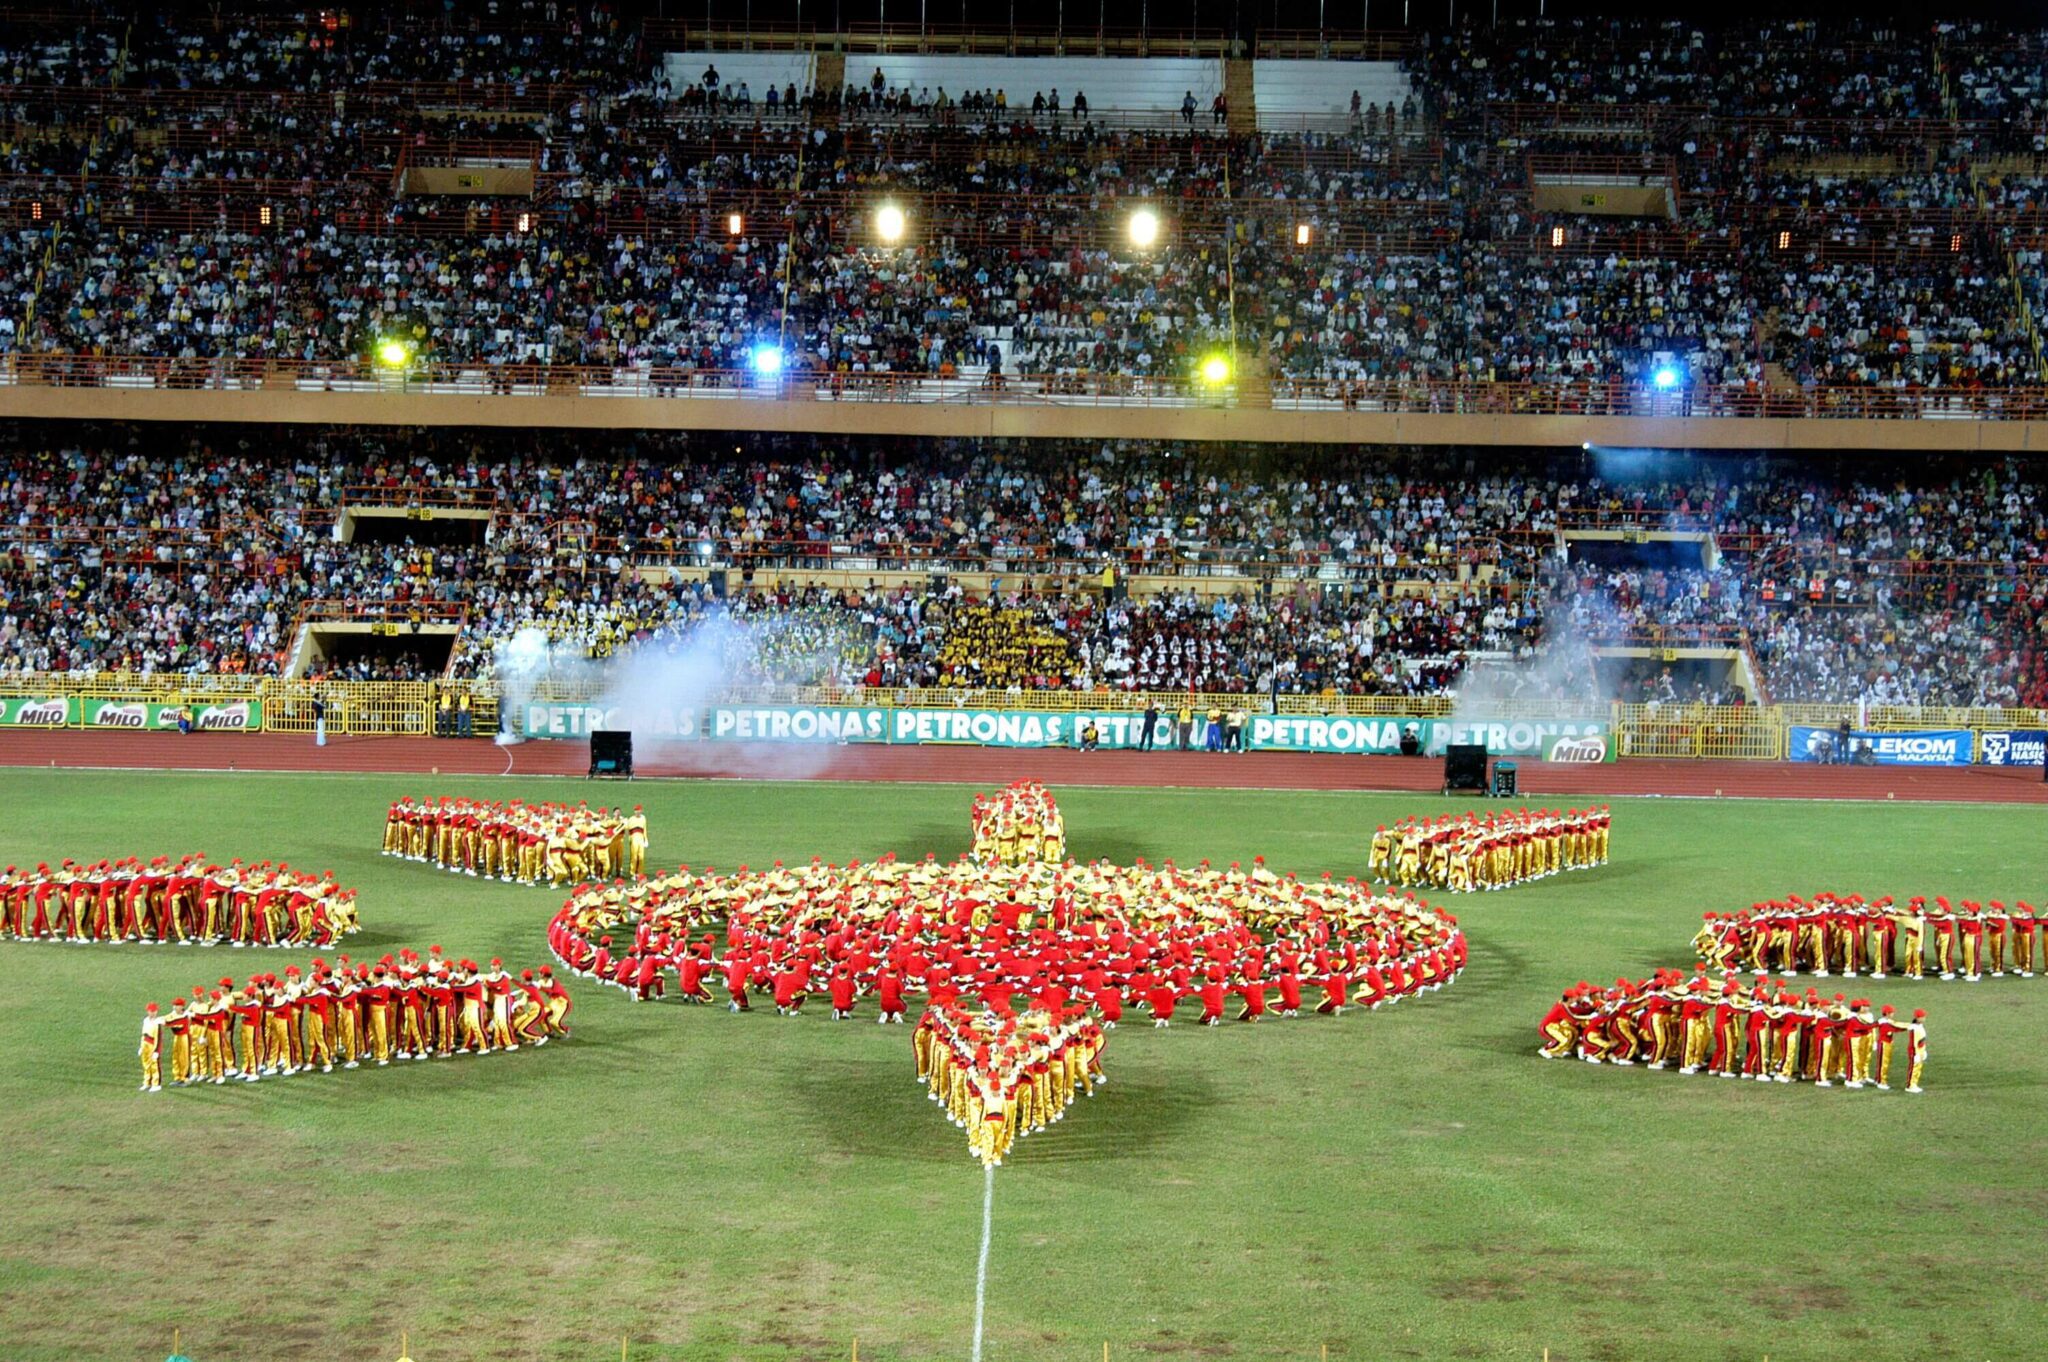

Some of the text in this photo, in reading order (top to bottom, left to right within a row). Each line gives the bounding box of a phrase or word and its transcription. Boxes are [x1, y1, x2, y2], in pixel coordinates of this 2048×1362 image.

[20, 709, 63, 724] MILO
[99, 710, 143, 727] MILO
[161, 712, 180, 721] MIL
[201, 714, 244, 728] MILO
[716, 710, 881, 739] PETRONAS
[897, 711, 1061, 743] PETRONAS
[1554, 746, 1601, 761] MILO
[1896, 753, 1954, 762] MALAYSIA
